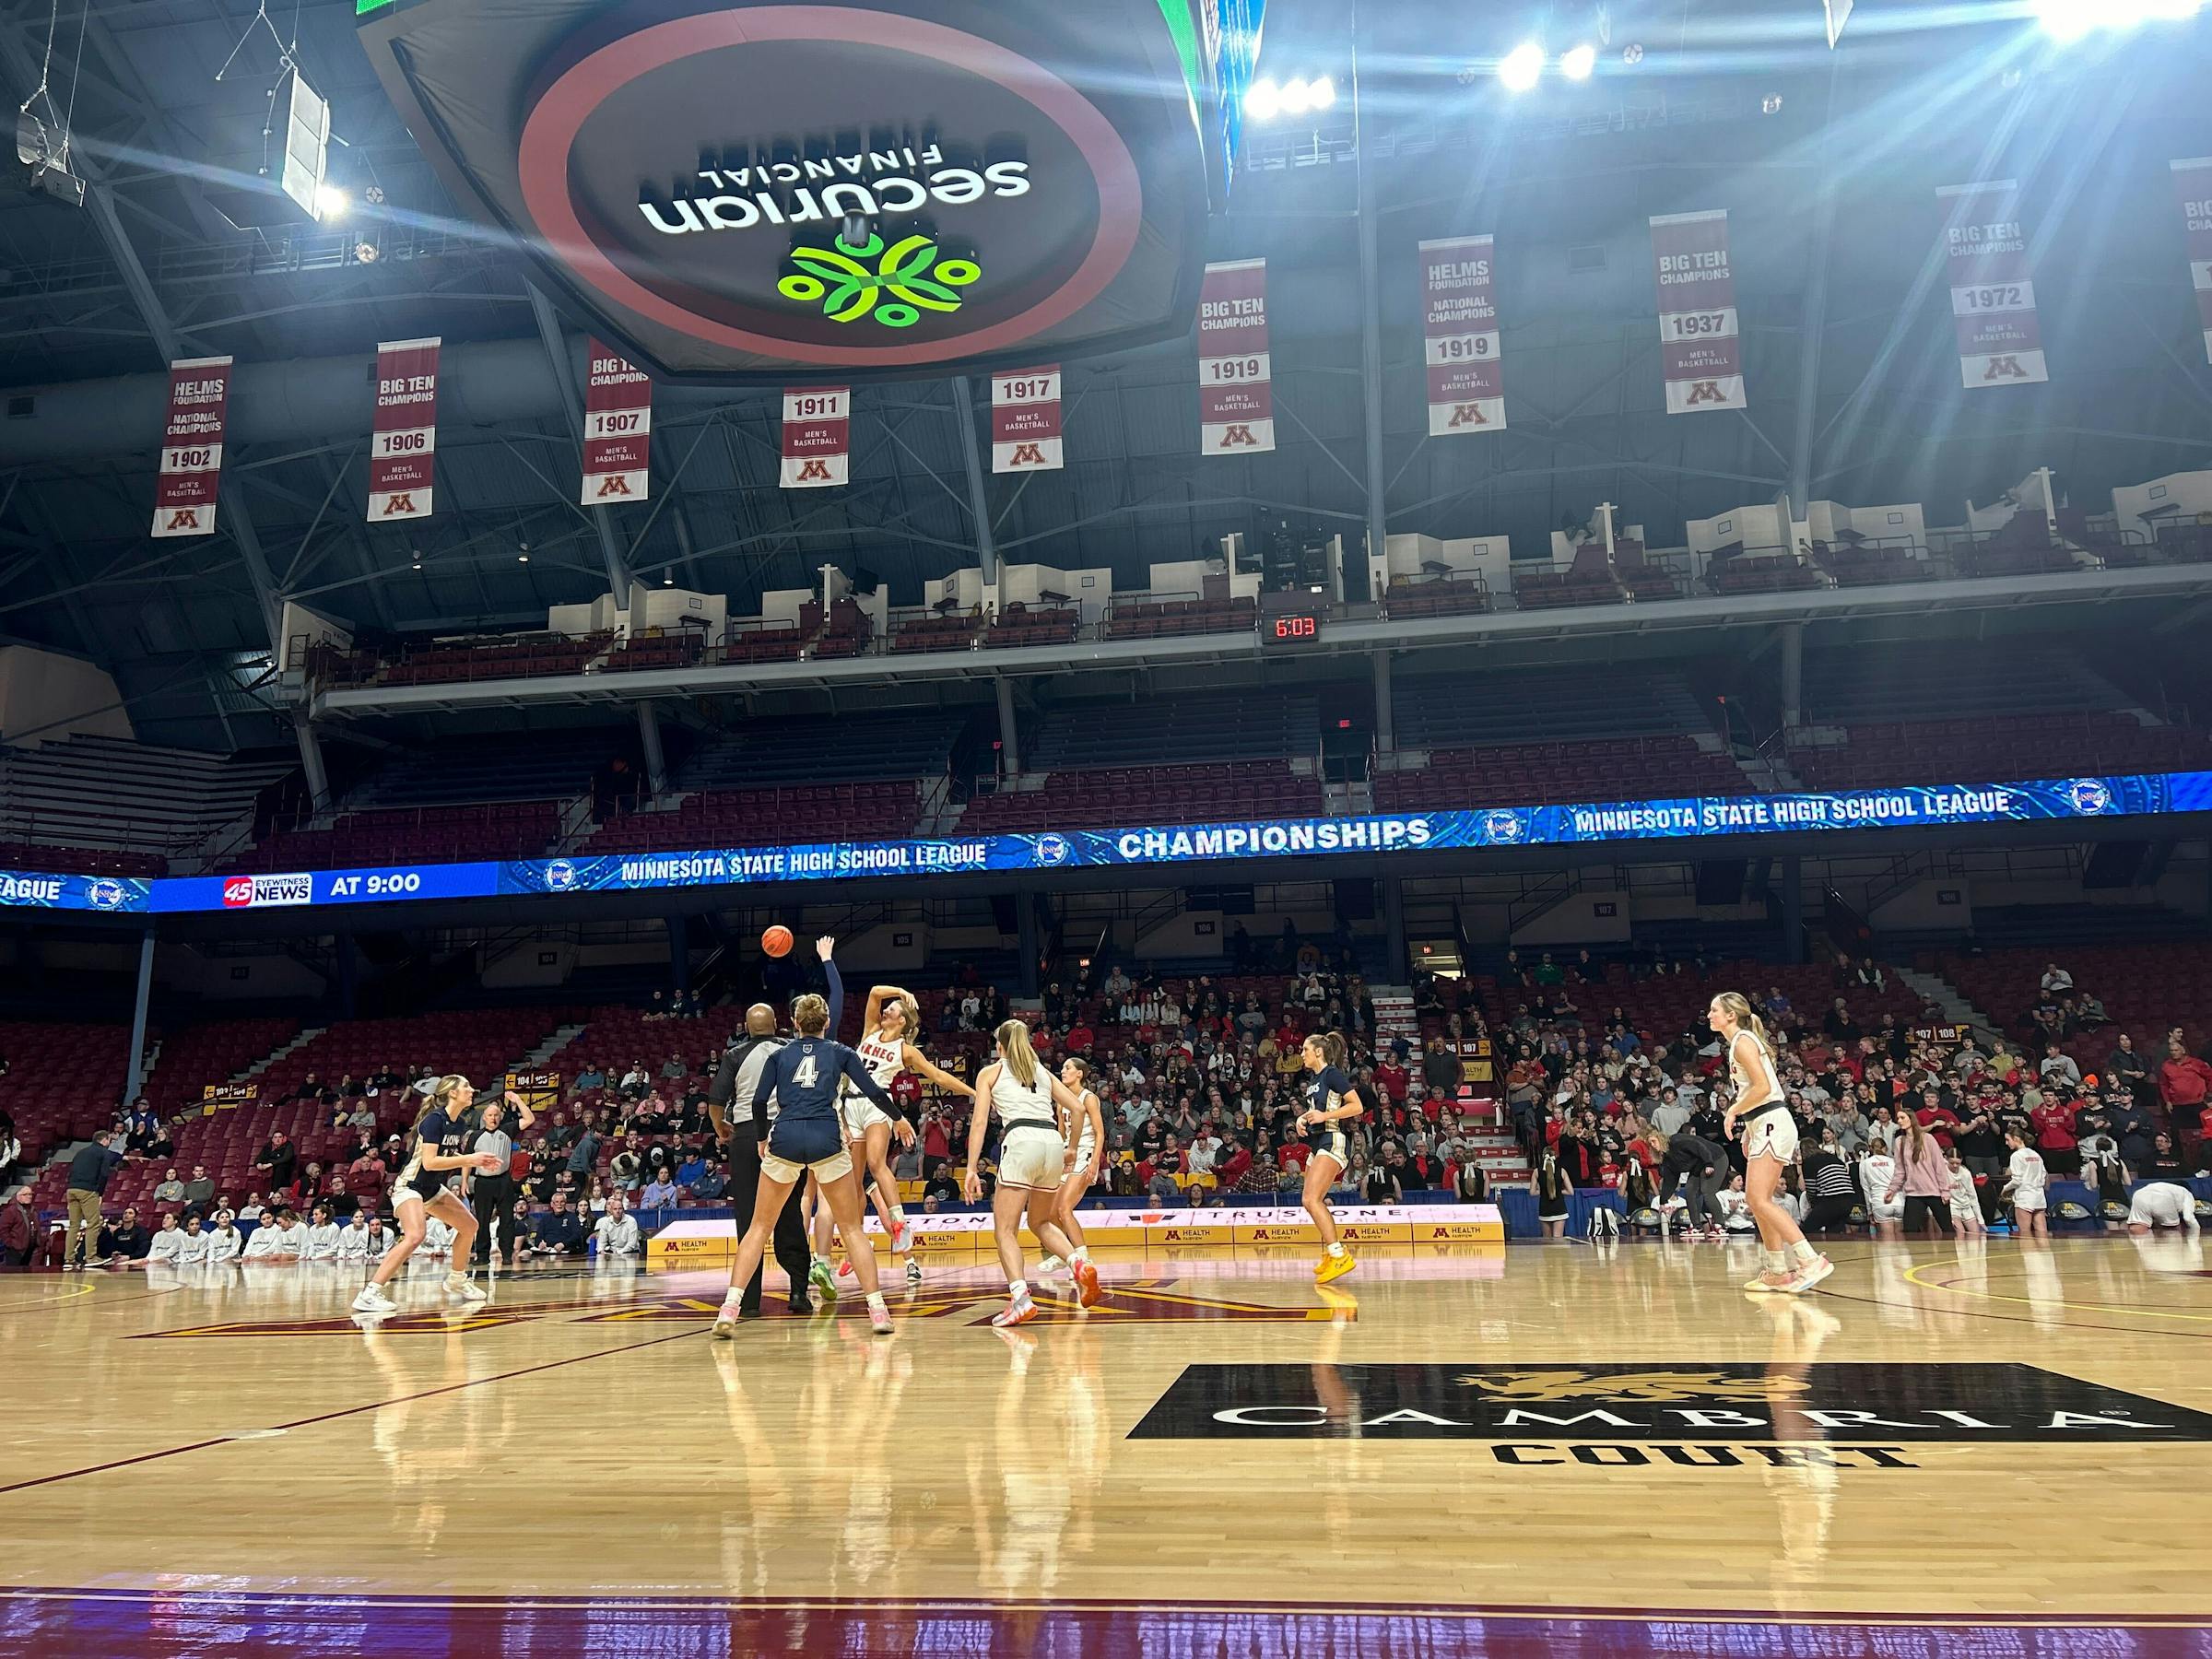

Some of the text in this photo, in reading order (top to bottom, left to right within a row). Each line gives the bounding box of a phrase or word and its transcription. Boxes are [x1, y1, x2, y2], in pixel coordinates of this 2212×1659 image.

[698, 143, 943, 190] FINANCIAL
[638, 160, 1031, 235] securian
[1948, 221, 2021, 244] BIG TEN
[1950, 240, 2024, 257] CHAMPIONS
[1659, 250, 1727, 273] BIG TEN
[1429, 259, 1488, 281] HELMS
[1660, 268, 1730, 286] CHAMPIONS
[1429, 276, 1489, 290] FOUNDATION
[1433, 296, 1488, 312] NATIONAL
[1966, 287, 2022, 308] 1972
[1201, 297, 1265, 318] BIG TEN
[1428, 306, 1495, 324] CHAMPIONS
[1201, 314, 1265, 331] CHAMPIONS
[1673, 313, 1725, 335] 1937
[1438, 337, 1488, 359] 1919
[1689, 350, 1715, 359] MEN'S
[592, 358, 617, 374] BIG
[1211, 359, 1259, 380] 1919
[1678, 357, 1729, 369] BASKETBALL
[380, 375, 435, 394] BIG TEN
[590, 371, 649, 386] CHAMPIONS
[1453, 372, 1477, 382] MEN'S
[174, 379, 224, 396] HELMS
[1004, 380, 1050, 399] 1917
[1441, 379, 1489, 392] BASKETBALL
[172, 394, 222, 406] FOUNDATION
[378, 391, 434, 406] CHAMPIONS
[794, 397, 837, 416] 1911
[1214, 400, 1260, 412] BASKETBALL
[1225, 394, 1249, 403] MEN'S
[173, 411, 218, 423] NATIONAL
[596, 414, 640, 432] 1907
[1016, 413, 1039, 422] MEN'S
[167, 421, 221, 435] CHAMPIONS
[1005, 420, 1050, 431] BASKETBALL
[383, 433, 425, 453] 1906
[606, 446, 628, 455] MEN'S
[794, 438, 838, 447] BASKETBALL
[171, 450, 210, 467] 1902
[594, 453, 637, 464] BASKETBALL
[382, 471, 422, 482] BASKETBALL
[392, 465, 412, 474] MEN'S
[167, 488, 206, 497] BASKETBALL
[179, 481, 199, 489] MEN'S
[1277, 618, 1315, 637] 6:03
[1575, 791, 2010, 833] MINNESOTA STATE HIGH SCHOOL LEAGUE
[1118, 818, 1431, 858] CHAMPIONSHIPS
[621, 843, 986, 881] MINNESOTA STATE HIGH SCHOOL LEAGUE
[224, 881, 252, 900] 45
[255, 877, 310, 888] EYEWITNESS
[330, 873, 420, 897] AT 9:00
[255, 886, 309, 901] NEWS
[1916, 1028, 1955, 1039] 107 108
[1445, 1043, 1477, 1053] 06 107
[792, 1054, 818, 1088] 4
[940, 1059, 953, 1068] 106
[517, 1076, 530, 1085] 104
[1766, 1124, 1774, 1135] P
[1492, 1445, 1922, 1468] COURT
